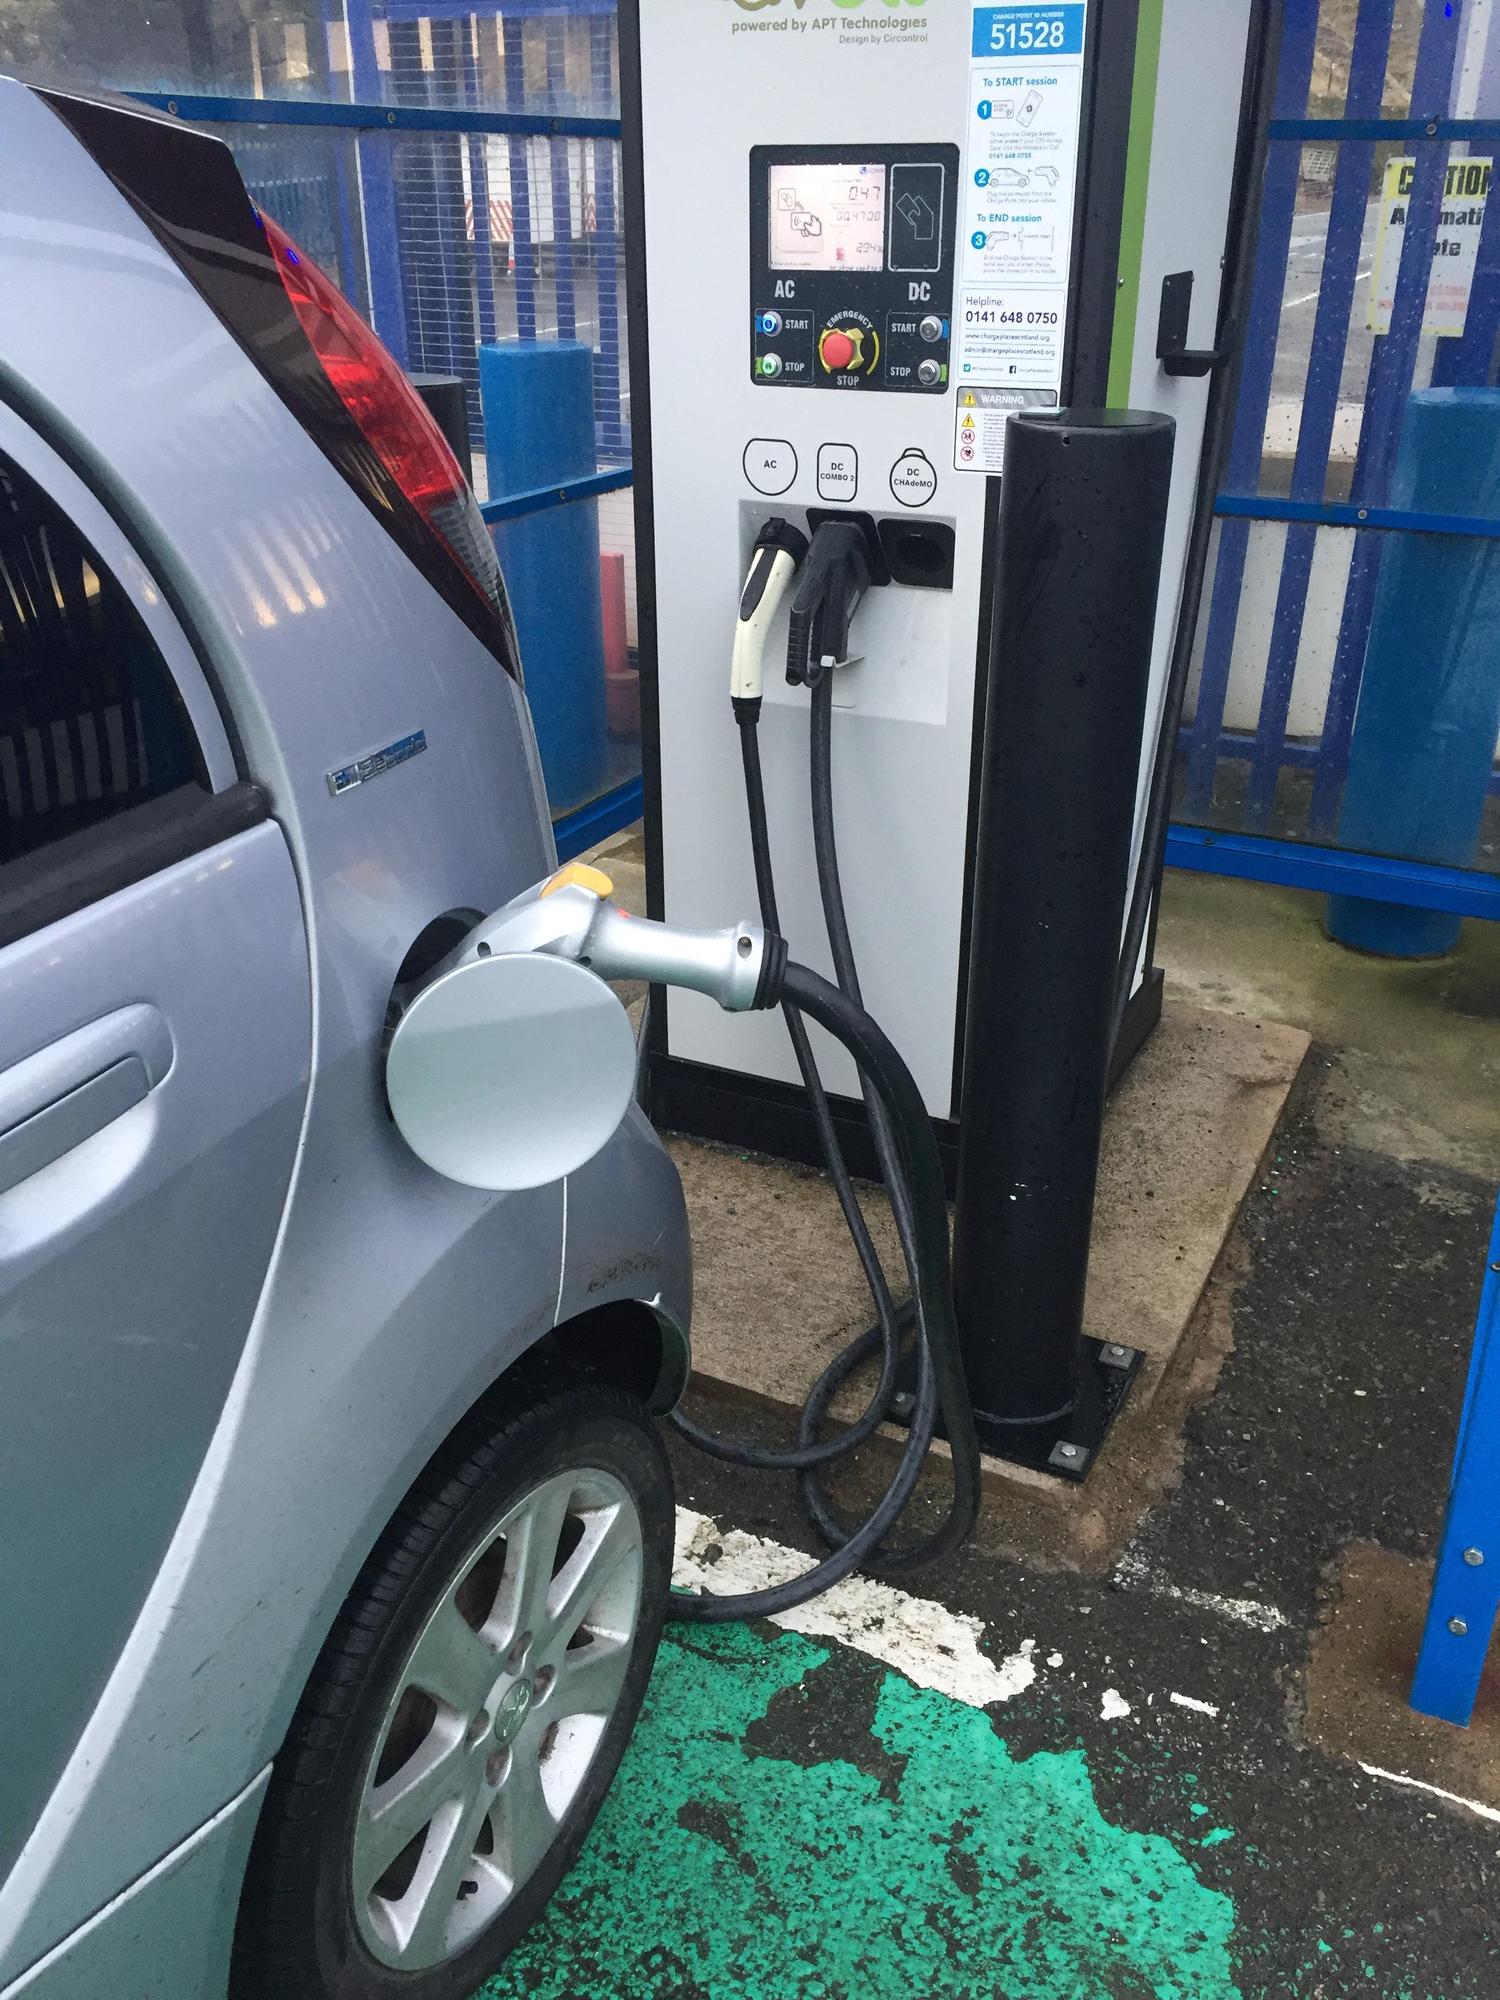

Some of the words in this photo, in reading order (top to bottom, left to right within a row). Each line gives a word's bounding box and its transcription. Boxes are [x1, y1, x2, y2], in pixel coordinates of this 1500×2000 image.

[731, 18, 788, 35] powered
[791, 18, 807, 33] by
[812, 17, 837, 30] APT
[840, 16, 928, 32] Technologies
[839, 34, 869, 45] Design
[870, 34, 881, 44] by
[883, 33, 929, 43] Circontrol
[990, 20, 1065, 50] 51528
[982, 78, 993, 87] To
[996, 77, 1024, 86] START
[1026, 76, 1058, 86] session
[977, 214, 986, 222] To
[989, 214, 1010, 222] END
[1010, 213, 1042, 222] session
[774, 279, 795, 298] AC
[908, 281, 931, 302] DC
[966, 296, 1004, 308] Helpline:
[826, 310, 874, 330] EMERGENCY
[966, 310, 995, 322] 0141
[1000, 312, 1023, 323] 648
[1027, 312, 1058, 324] 0750
[785, 319, 809, 330] START
[891, 323, 917, 334] START
[965, 333, 1050, 342] www.chargeplacescotland.org
[964, 347, 1056, 356] admin@chargeplacescotland.org
[784, 361, 805, 372] STOP
[890, 366, 912, 376] STOP
[836, 376, 860, 386] STOP
[981, 394, 1025, 404] WARNING
[763, 460, 778, 470] AC
[830, 462, 844, 472] DC
[820, 472, 848, 482] COMBO
[906, 468, 920, 477] DC
[894, 478, 933, 488] CHAdeMO
